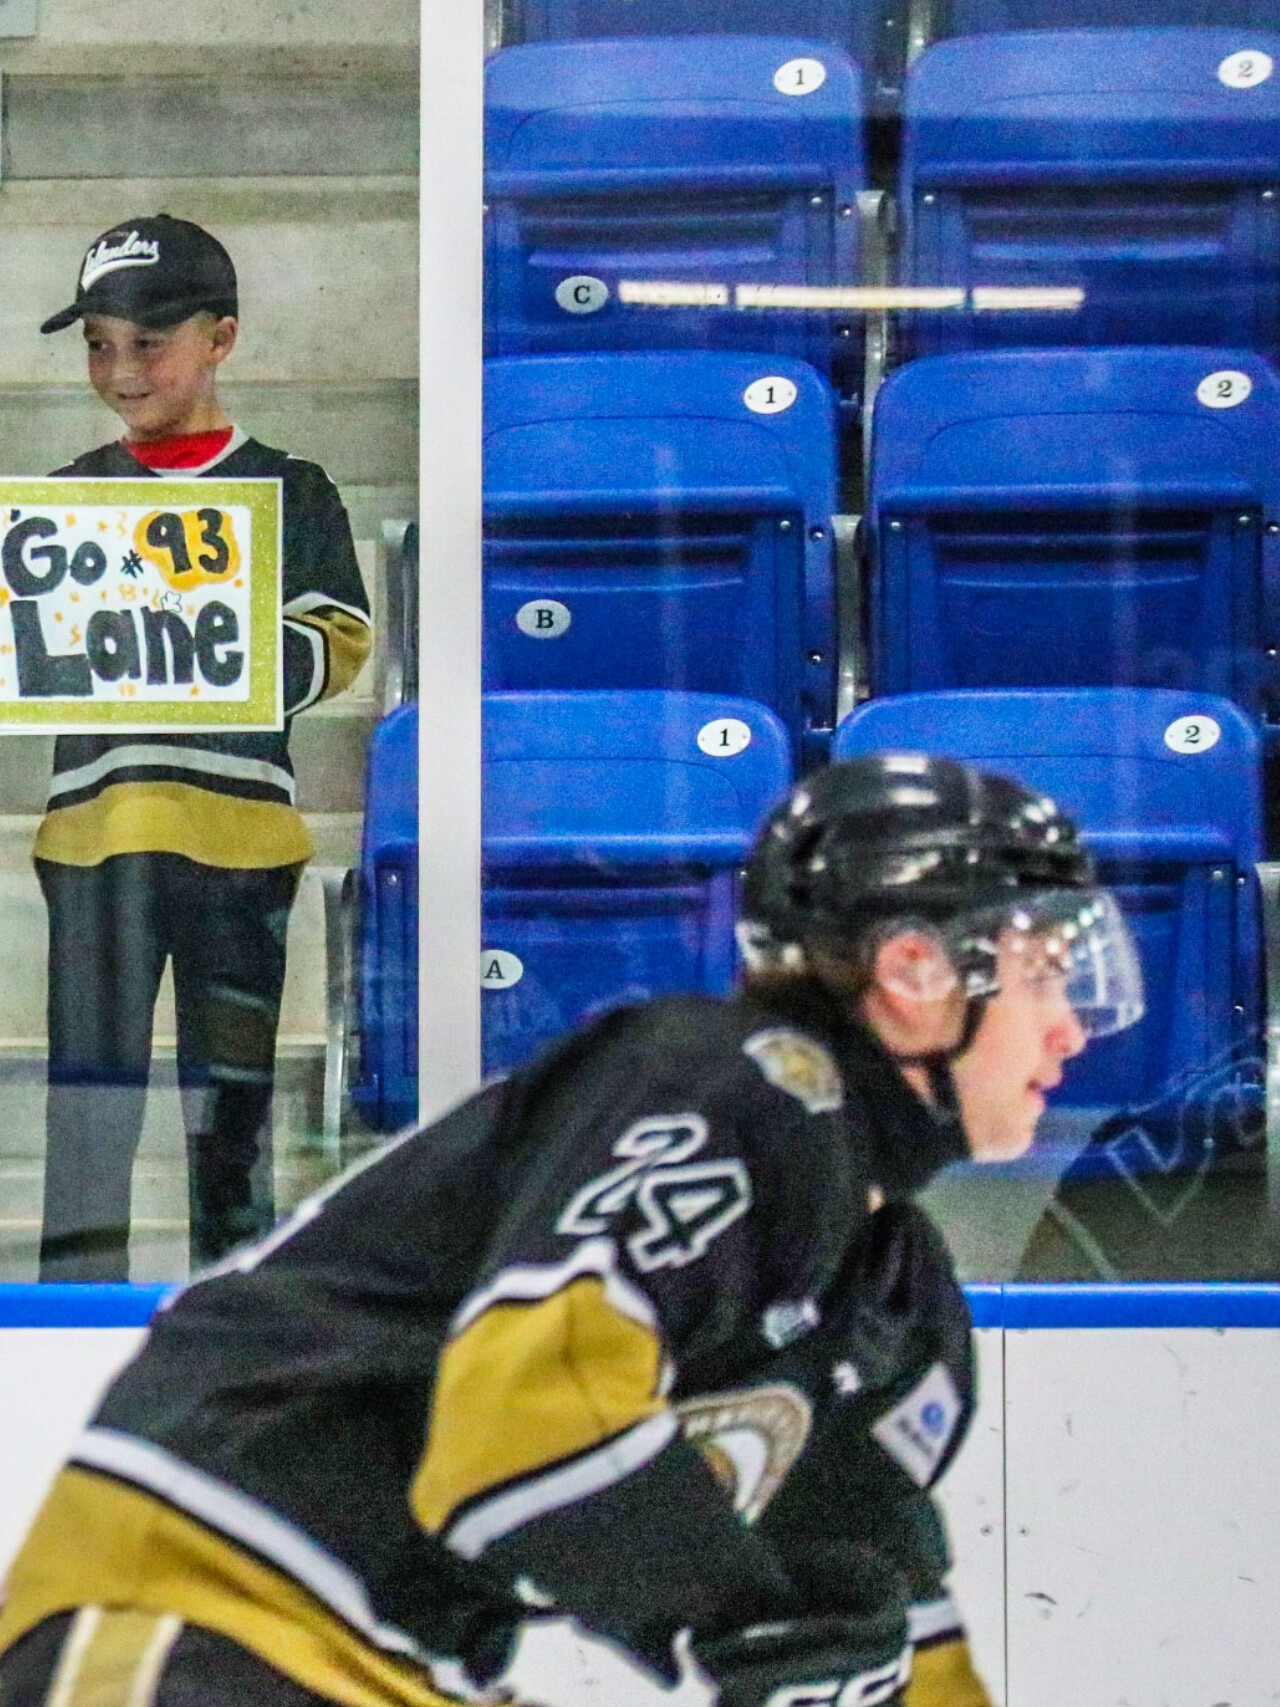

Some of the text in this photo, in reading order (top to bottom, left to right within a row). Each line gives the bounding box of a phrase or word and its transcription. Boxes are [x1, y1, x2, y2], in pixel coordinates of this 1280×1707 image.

[794, 68, 806, 86] 1
[1237, 60, 1254, 78] 2
[572, 285, 591, 304] C
[764, 386, 776, 403] 1
[1216, 379, 1233, 398] 2
[1, 516, 108, 598] Go
[535, 609, 555, 629] B
[9, 599, 245, 698] Lane
[718, 728, 731, 747] 1
[1183, 724, 1200, 745] 2
[484, 959, 505, 980] A
[554, 1112, 753, 1273] 24
